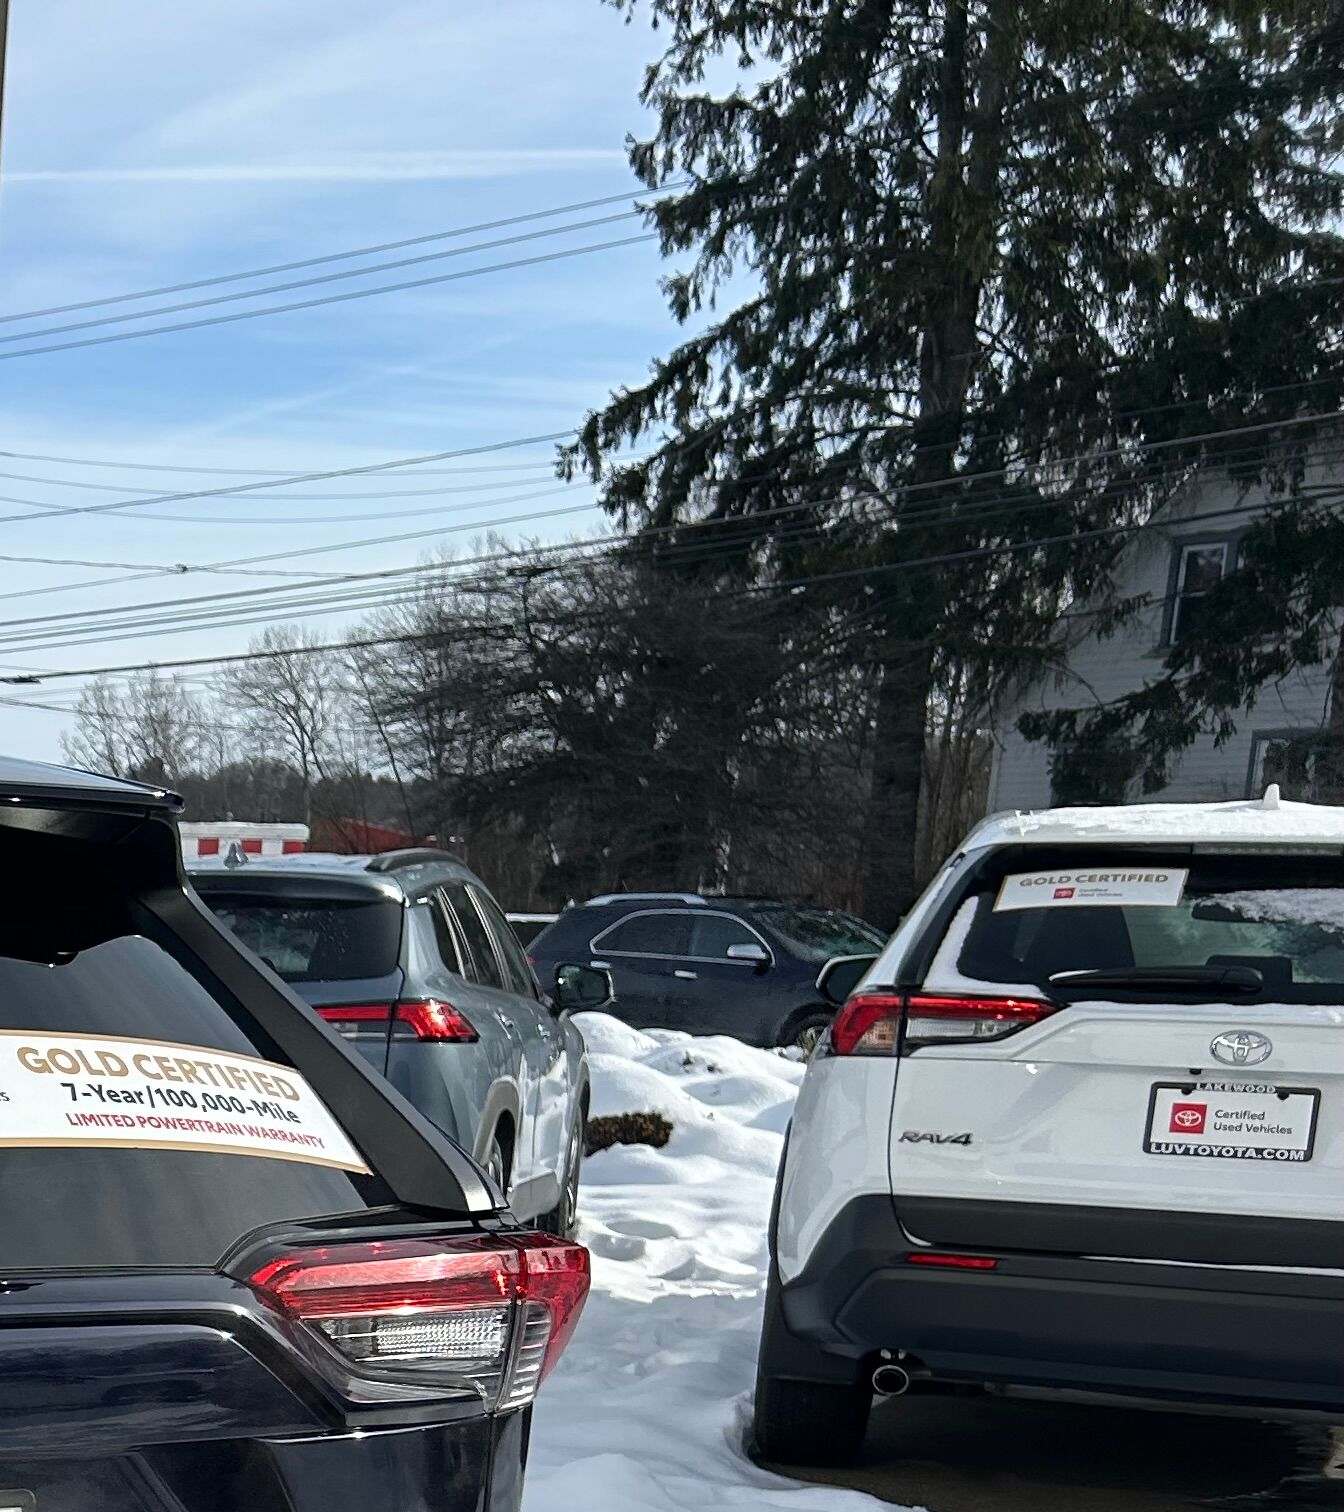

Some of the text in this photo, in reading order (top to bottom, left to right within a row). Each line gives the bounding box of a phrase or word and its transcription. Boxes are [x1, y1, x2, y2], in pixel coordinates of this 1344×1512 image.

[1020, 874, 1168, 887] GOLD CERTIFIED
[17, 1046, 299, 1101] GOLD CERTIFIED
[1196, 1083, 1275, 1093] LAKEWOOD
[60, 1082, 302, 1123] 7-Year/100,000-Mile
[1215, 1109, 1265, 1120] Certified
[66, 1113, 325, 1149] LIMITED POWERTRAIN WARRANTY
[1214, 1122, 1292, 1134] Used Vehicles
[898, 1131, 973, 1146] RAV4
[1150, 1143, 1304, 1161] LUVTOYOTA.COM
